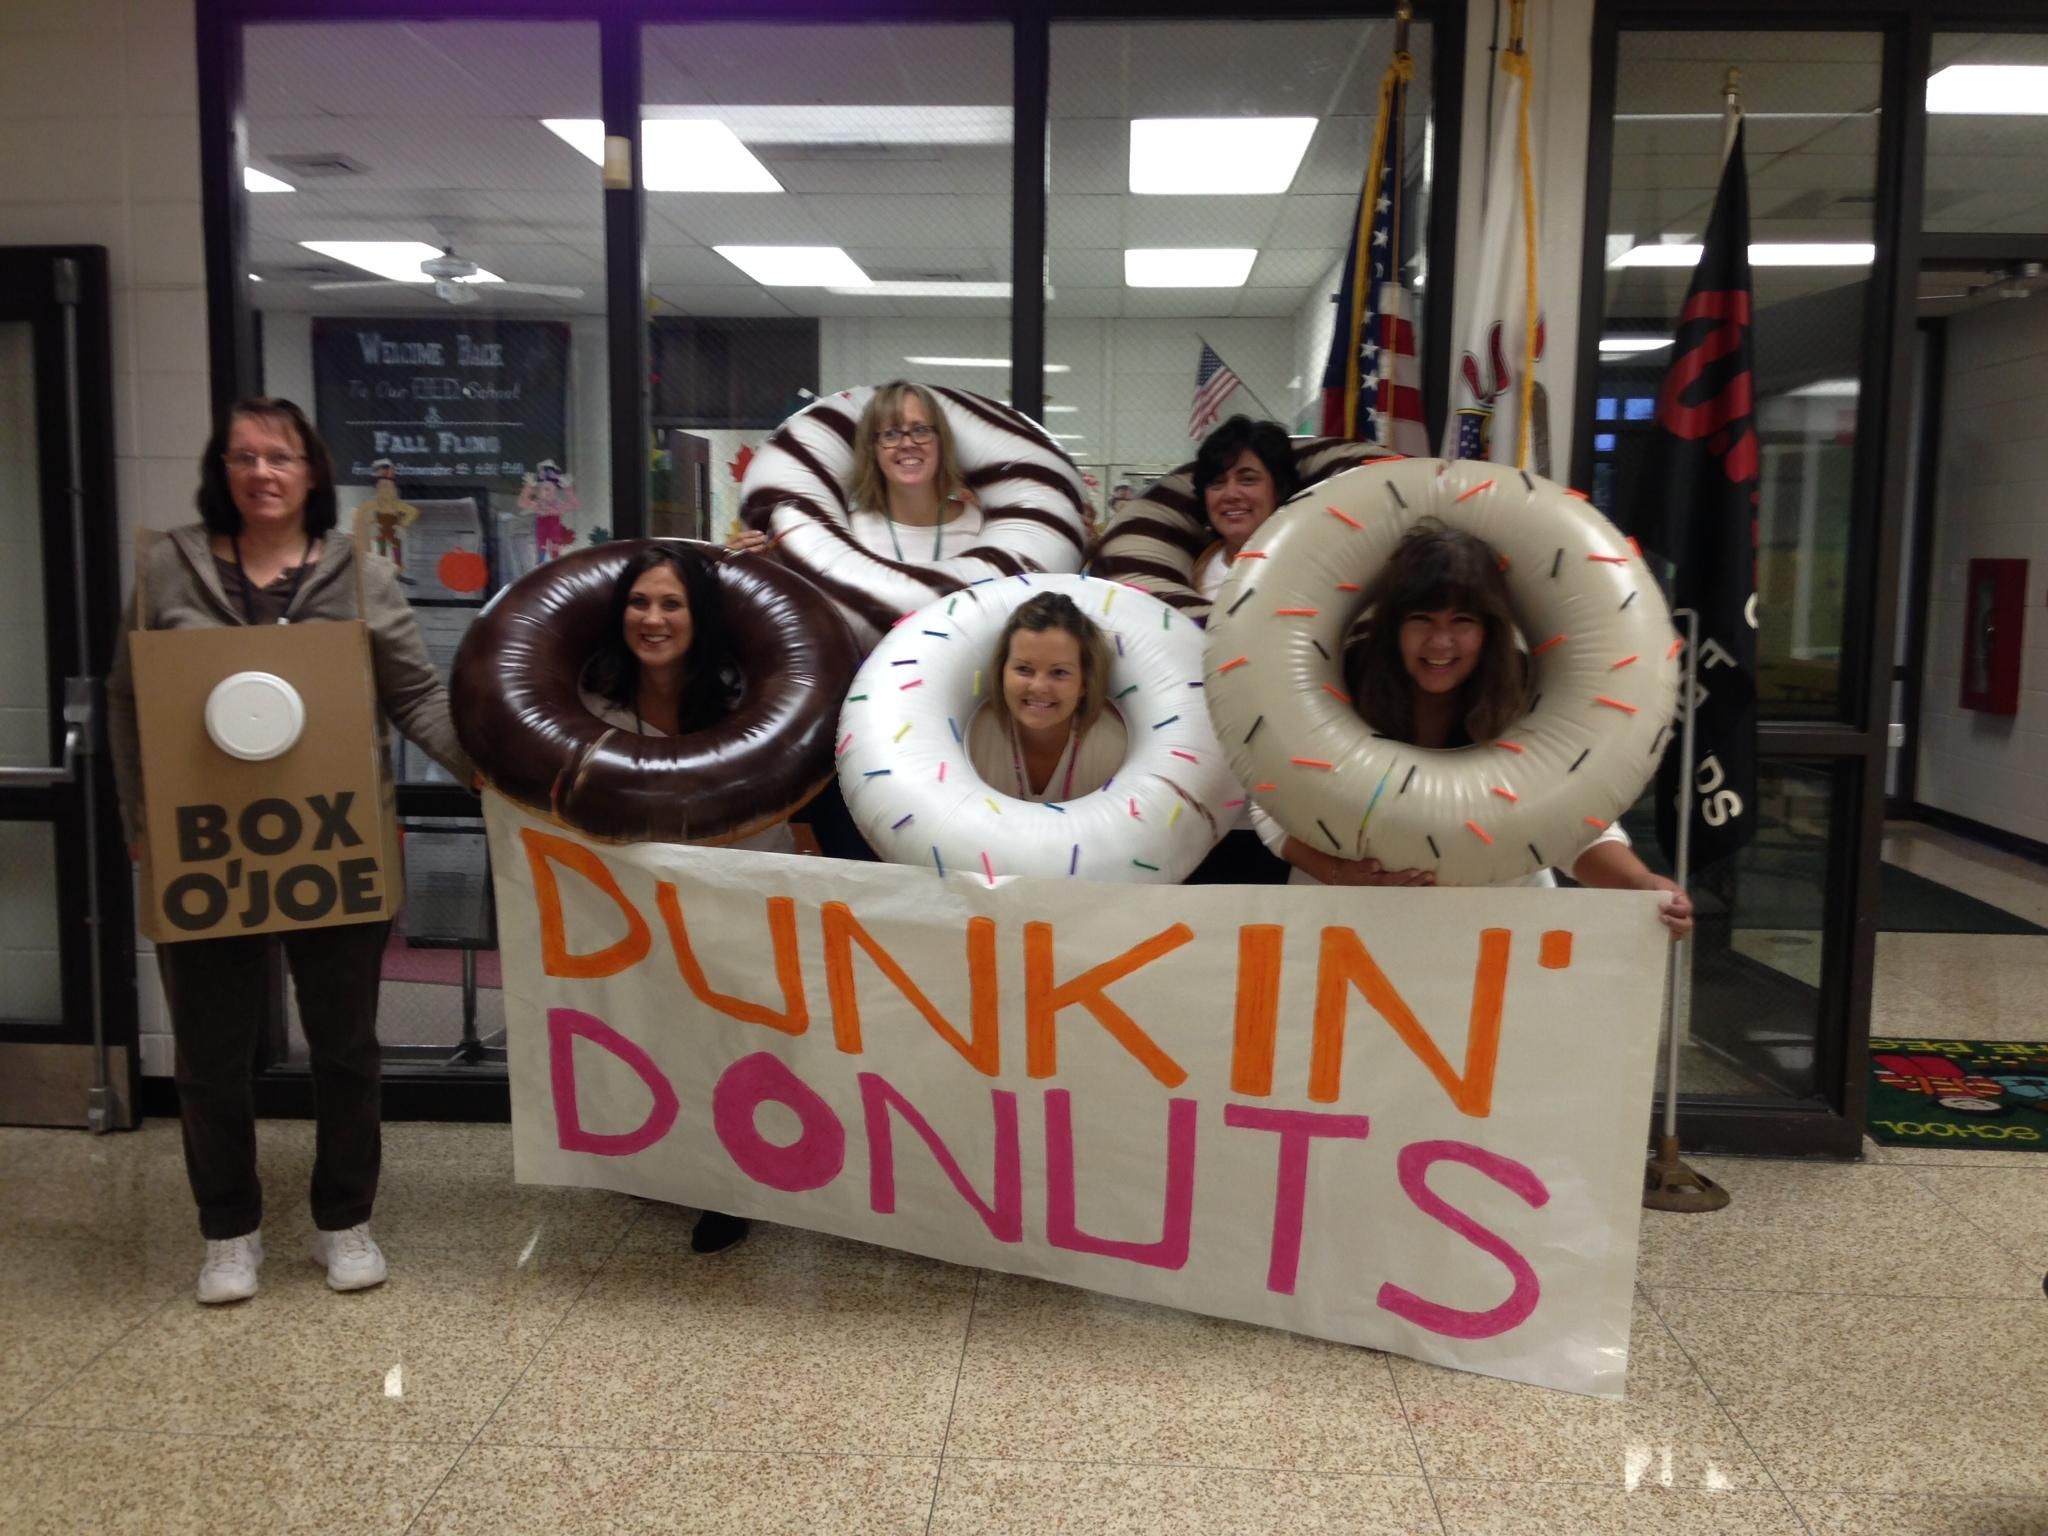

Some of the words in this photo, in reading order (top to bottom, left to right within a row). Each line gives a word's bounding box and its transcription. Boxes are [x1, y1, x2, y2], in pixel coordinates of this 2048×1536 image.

[373, 430, 430, 453] FALL
[437, 431, 501, 454] FLING
[176, 792, 363, 862] BOX
[162, 857, 382, 930] O'JOE
[521, 827, 1573, 1118] DUNKIN'
[1872, 1120, 2041, 1141] SCHOOL
[547, 1008, 1551, 1340] DONUTS
